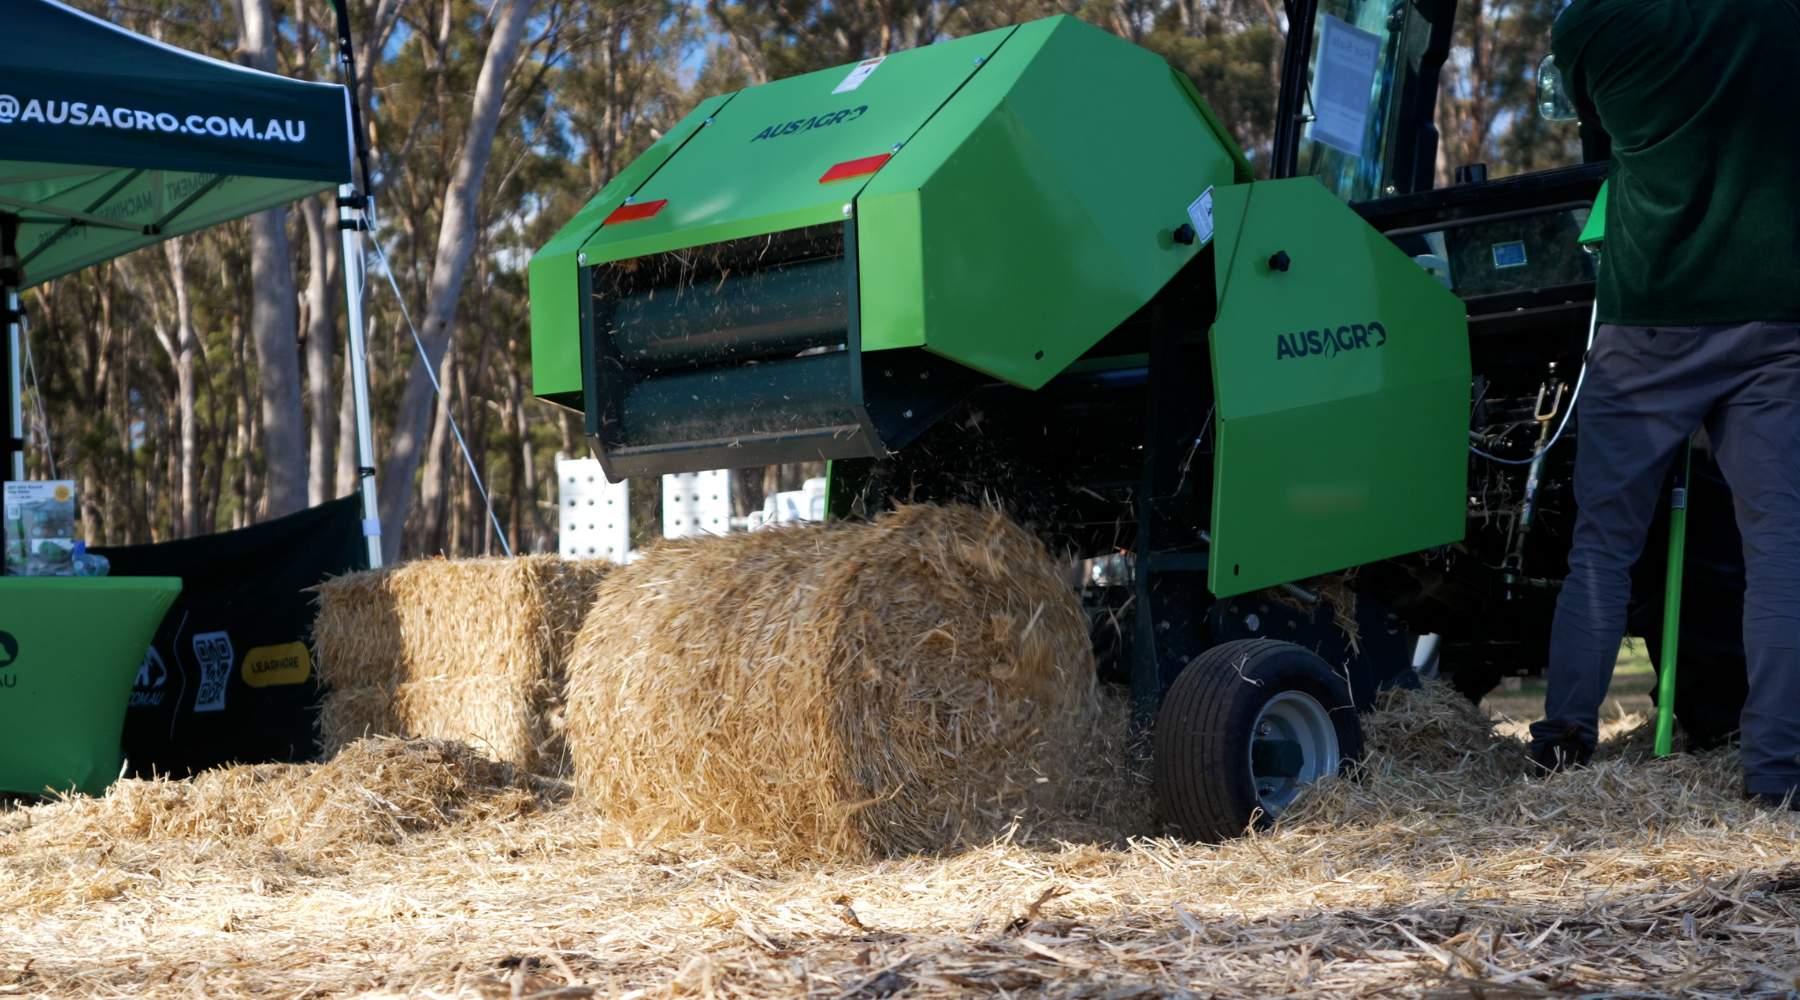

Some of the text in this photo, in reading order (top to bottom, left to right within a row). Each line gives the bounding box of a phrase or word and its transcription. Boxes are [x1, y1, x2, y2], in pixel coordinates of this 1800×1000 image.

[0, 94, 306, 142] @AUSAGRO.COM.AU
[750, 105, 868, 142] AUSAGRO
[1277, 321, 1386, 360] AUSAGRO
